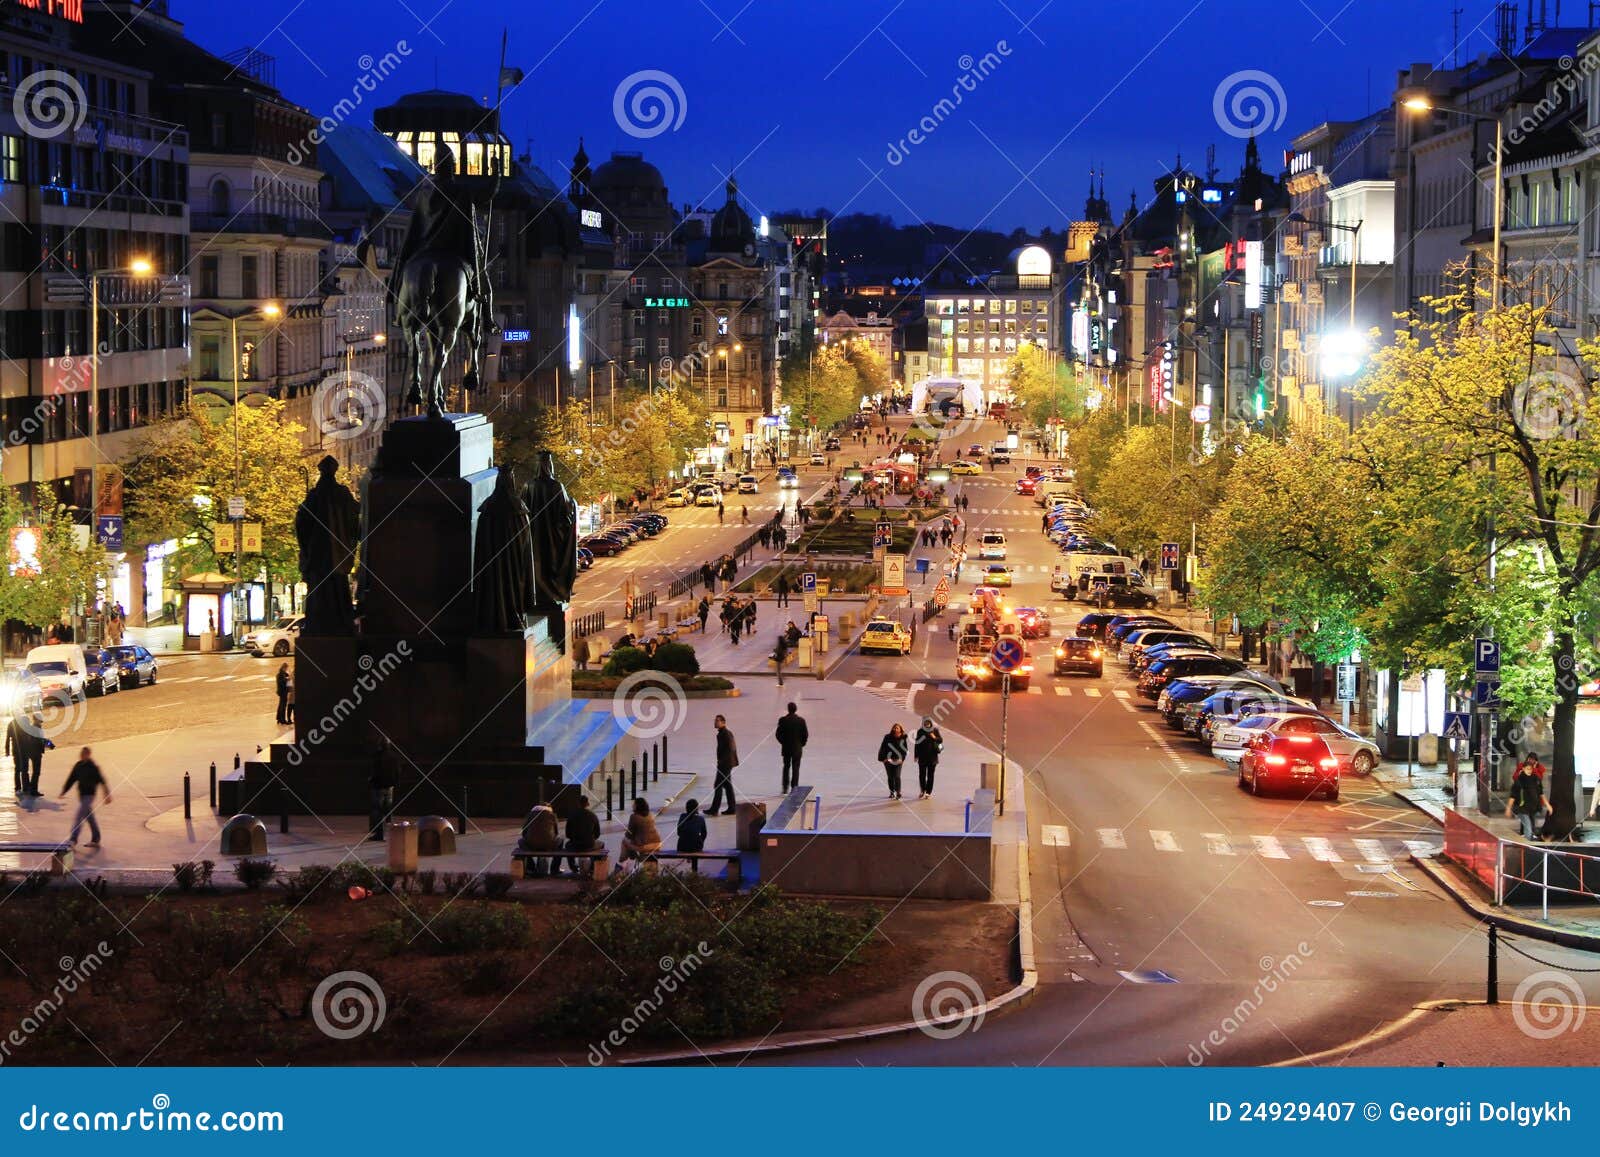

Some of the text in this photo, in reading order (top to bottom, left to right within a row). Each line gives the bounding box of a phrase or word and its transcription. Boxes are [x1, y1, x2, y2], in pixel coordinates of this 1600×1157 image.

[644, 298, 689, 307] LIGNA
[805, 575, 814, 587] P
[1480, 642, 1495, 662] P
